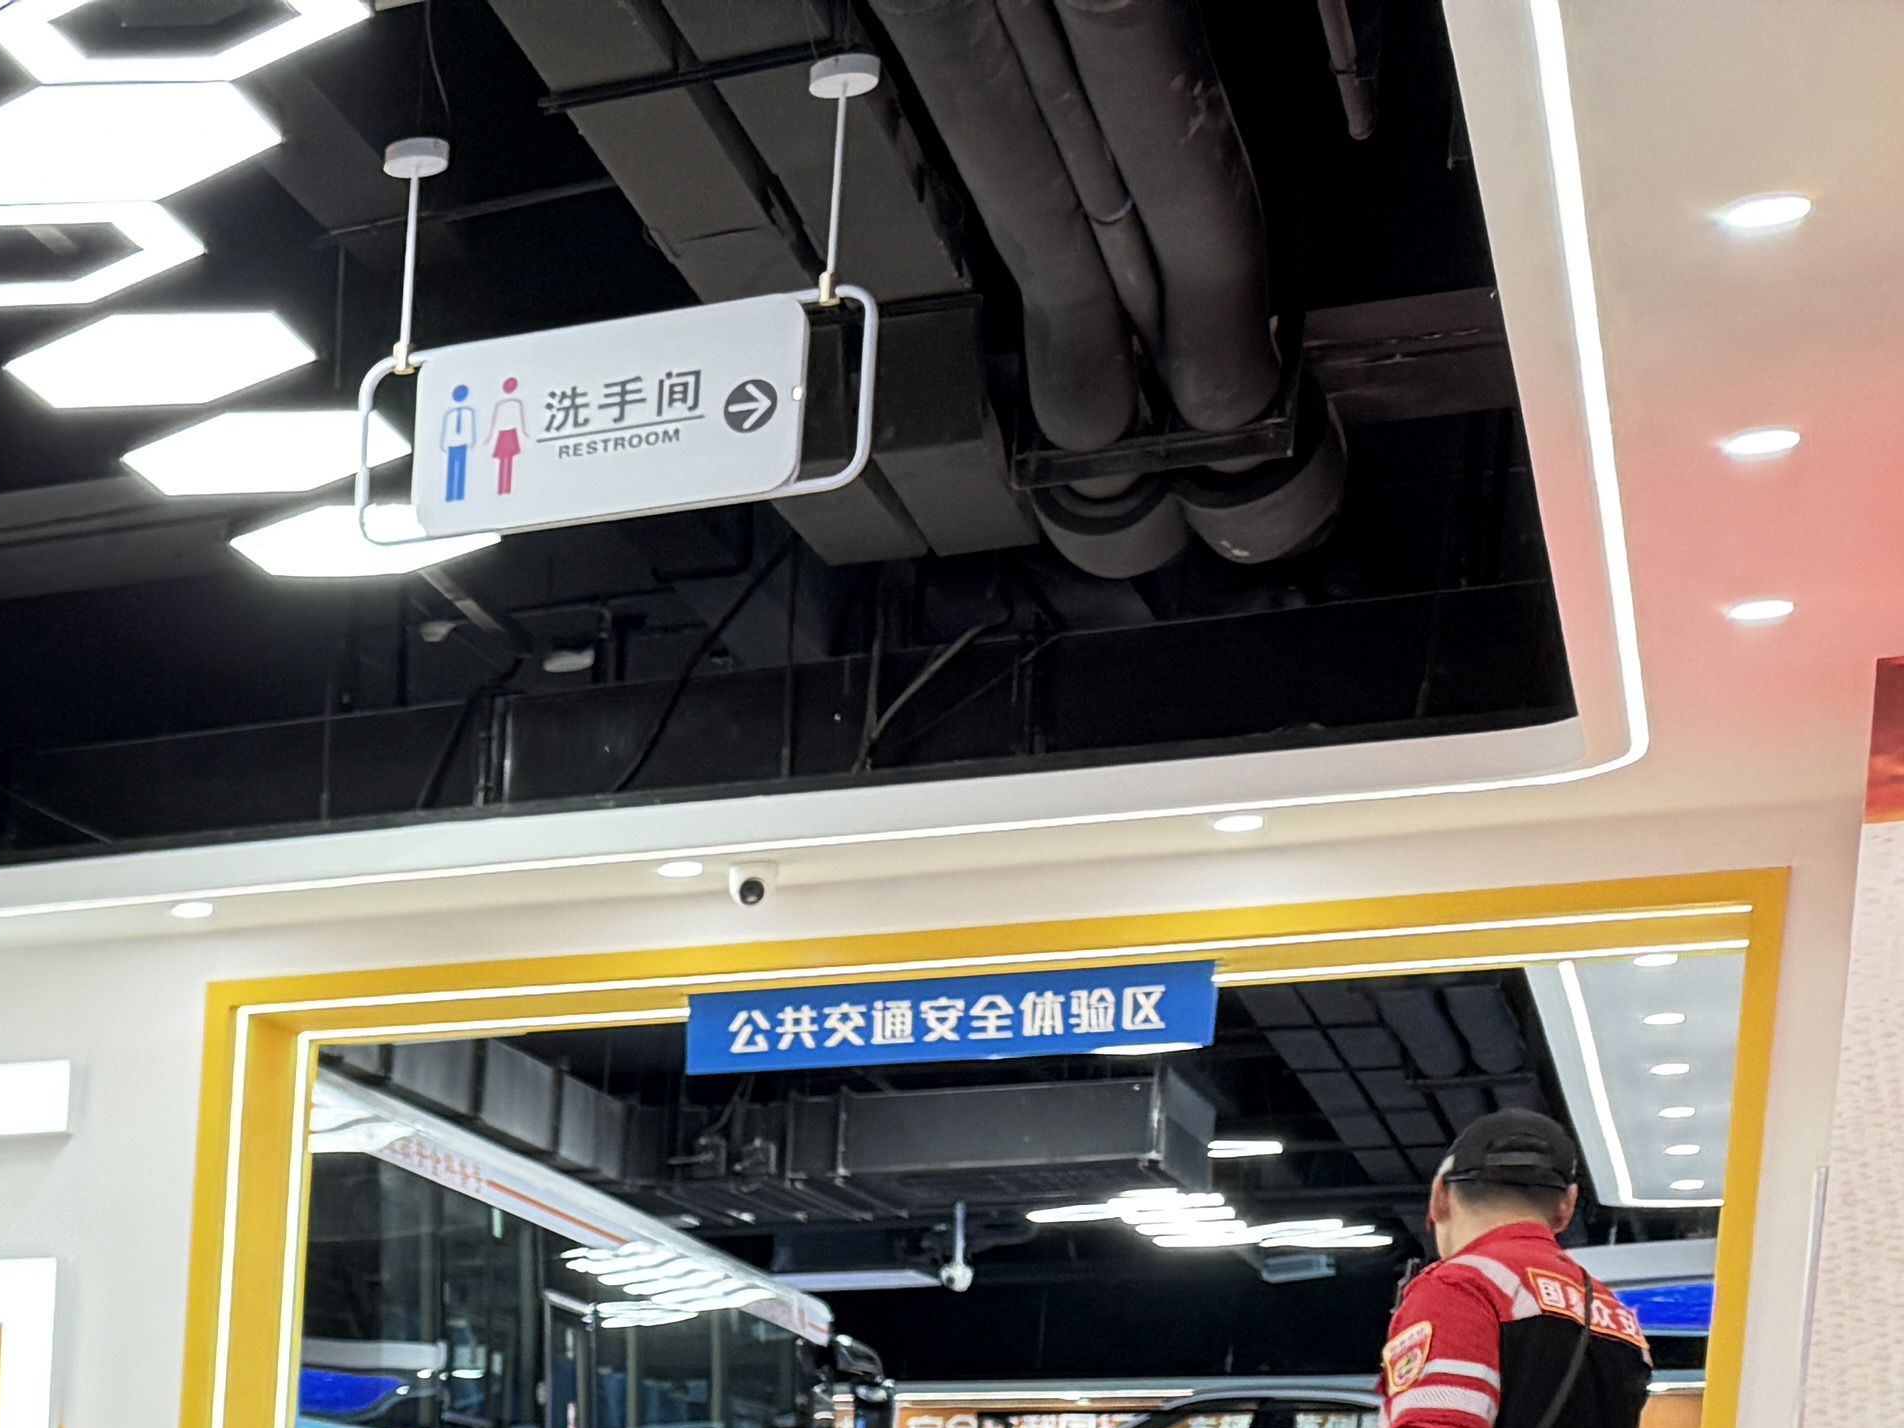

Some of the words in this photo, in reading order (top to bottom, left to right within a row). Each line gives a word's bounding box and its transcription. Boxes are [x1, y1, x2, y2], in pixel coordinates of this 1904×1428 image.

[543, 368, 703, 434] 洗手间
[558, 428, 680, 459] RESTROOM
[728, 985, 1166, 1054] 公共交通安全体验区
